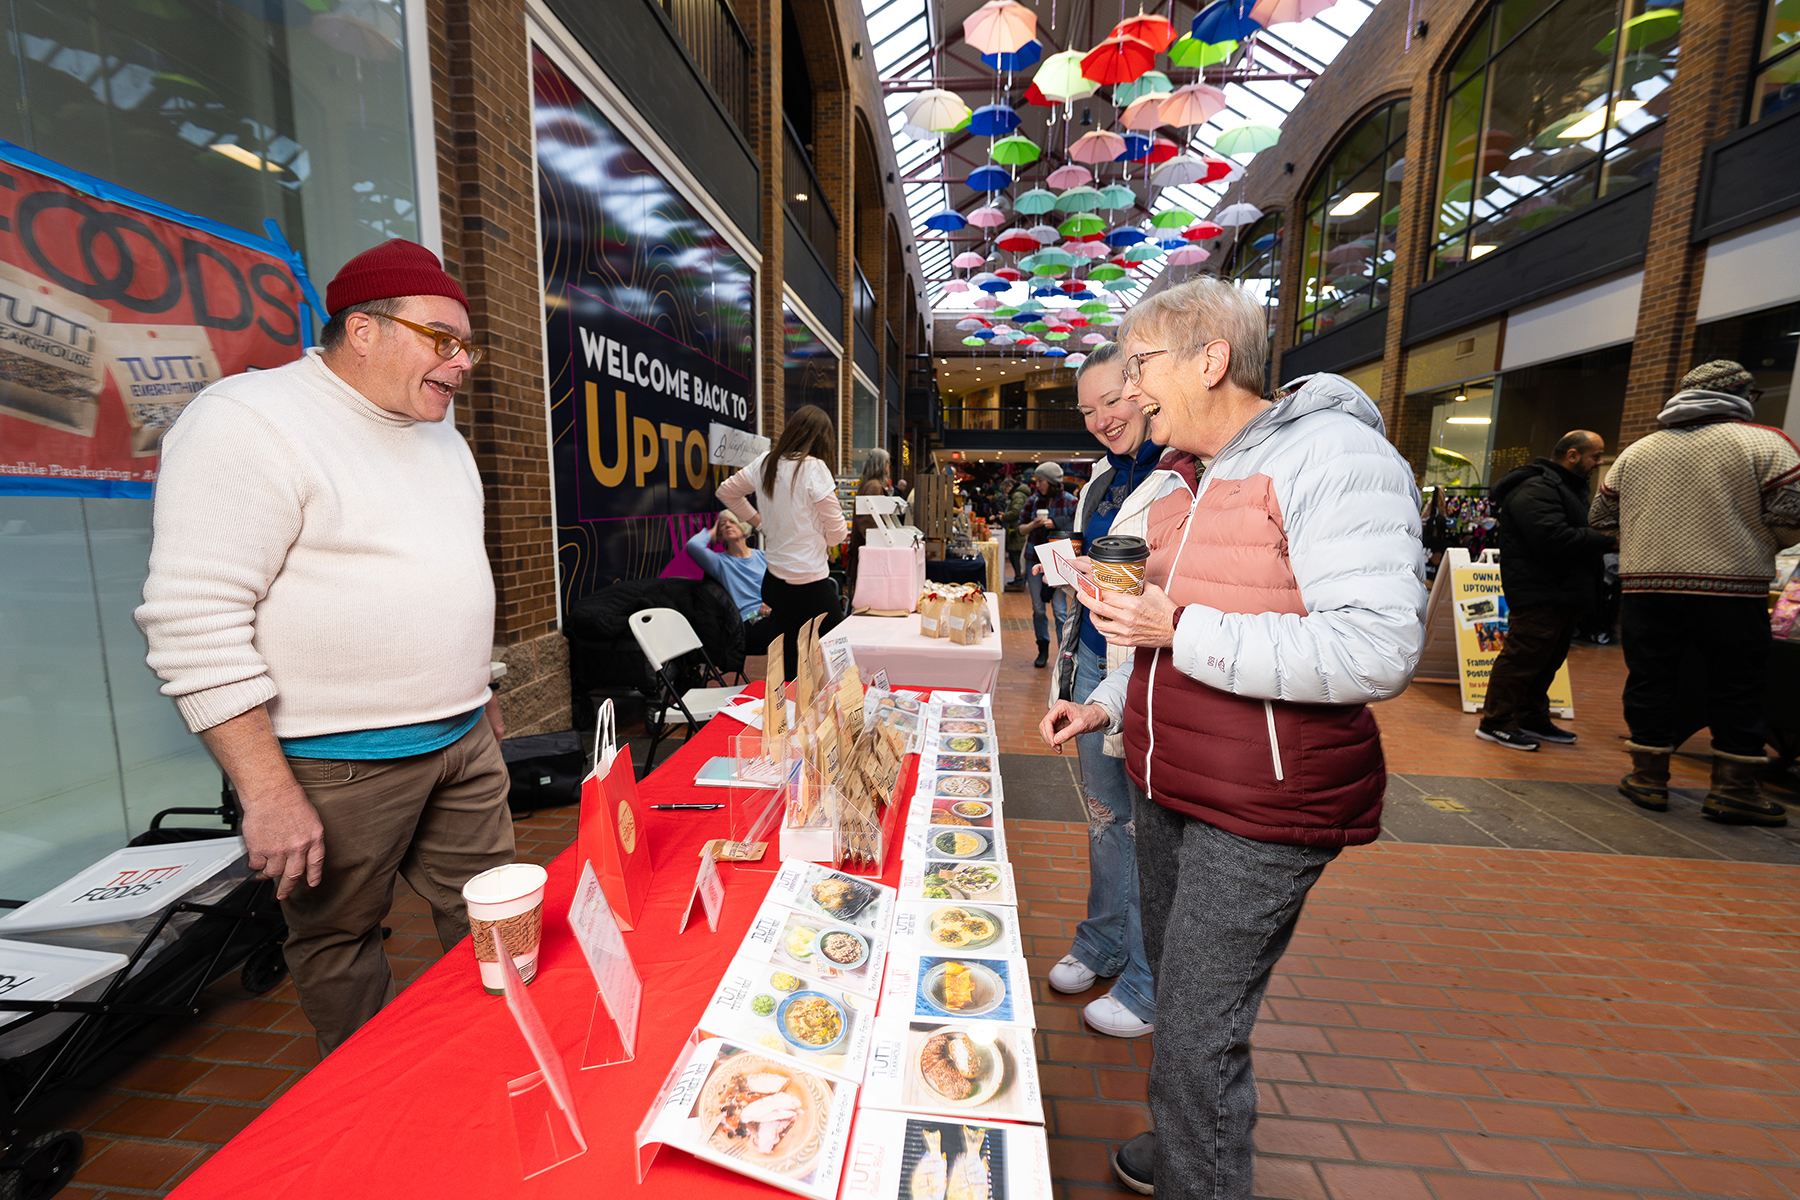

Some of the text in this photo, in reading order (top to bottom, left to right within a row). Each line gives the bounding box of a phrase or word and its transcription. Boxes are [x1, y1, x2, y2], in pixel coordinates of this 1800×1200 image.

[579, 326, 747, 422] WELCOME BACK TO
[584, 380, 738, 490] UPTO
[48, 464, 131, 480] Packaging
[1098, 573, 1122, 584] coffee
[1463, 584, 1502, 593] UPTOWN
[1473, 572, 1493, 581] OWN
[106, 864, 189, 887] TUTTi
[71, 881, 163, 903] FOODS
[751, 916, 774, 941] TUTTi
[872, 1040, 892, 1077] TUTTi
[890, 1041, 901, 1078] STEAKHOUSE
[850, 1142, 875, 1192] TUTTi
